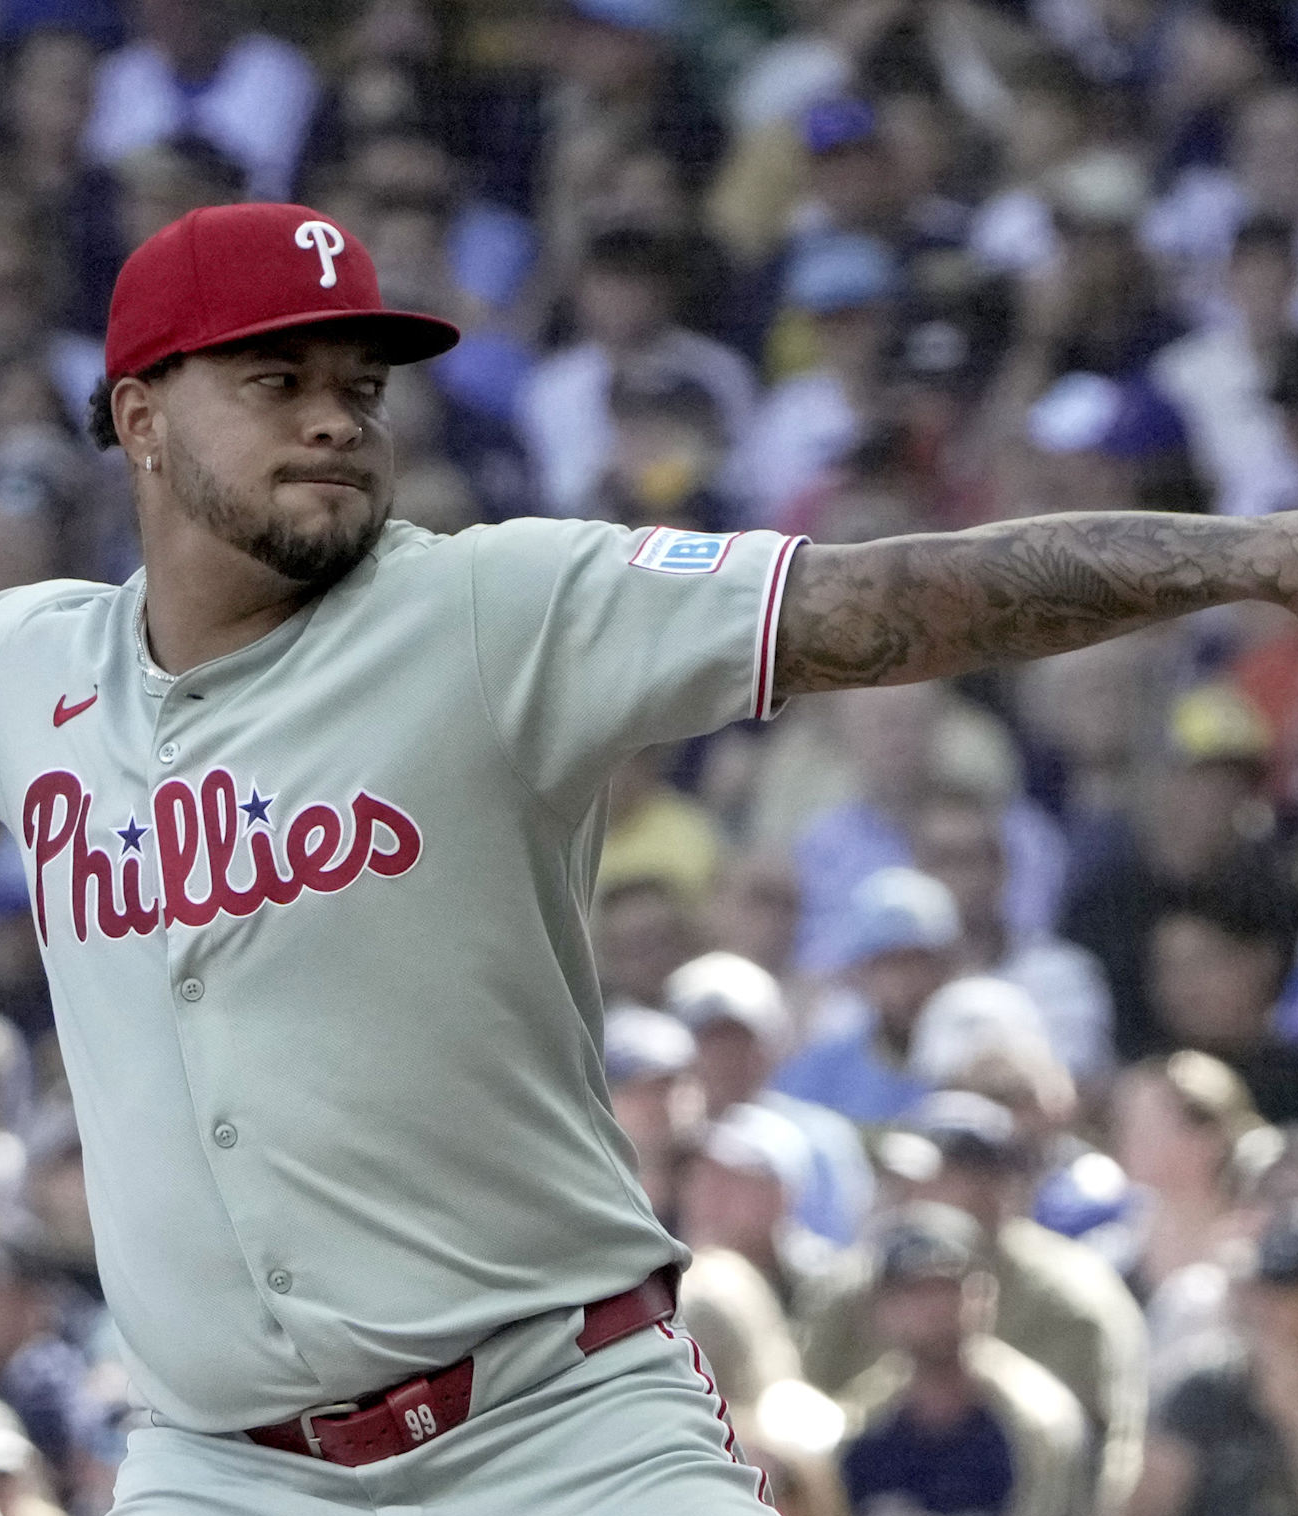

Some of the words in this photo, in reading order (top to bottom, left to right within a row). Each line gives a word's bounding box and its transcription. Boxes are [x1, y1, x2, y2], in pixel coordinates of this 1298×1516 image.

[294, 220, 345, 289] P
[22, 766, 424, 948] Phillies
[404, 1403, 438, 1442] 99
